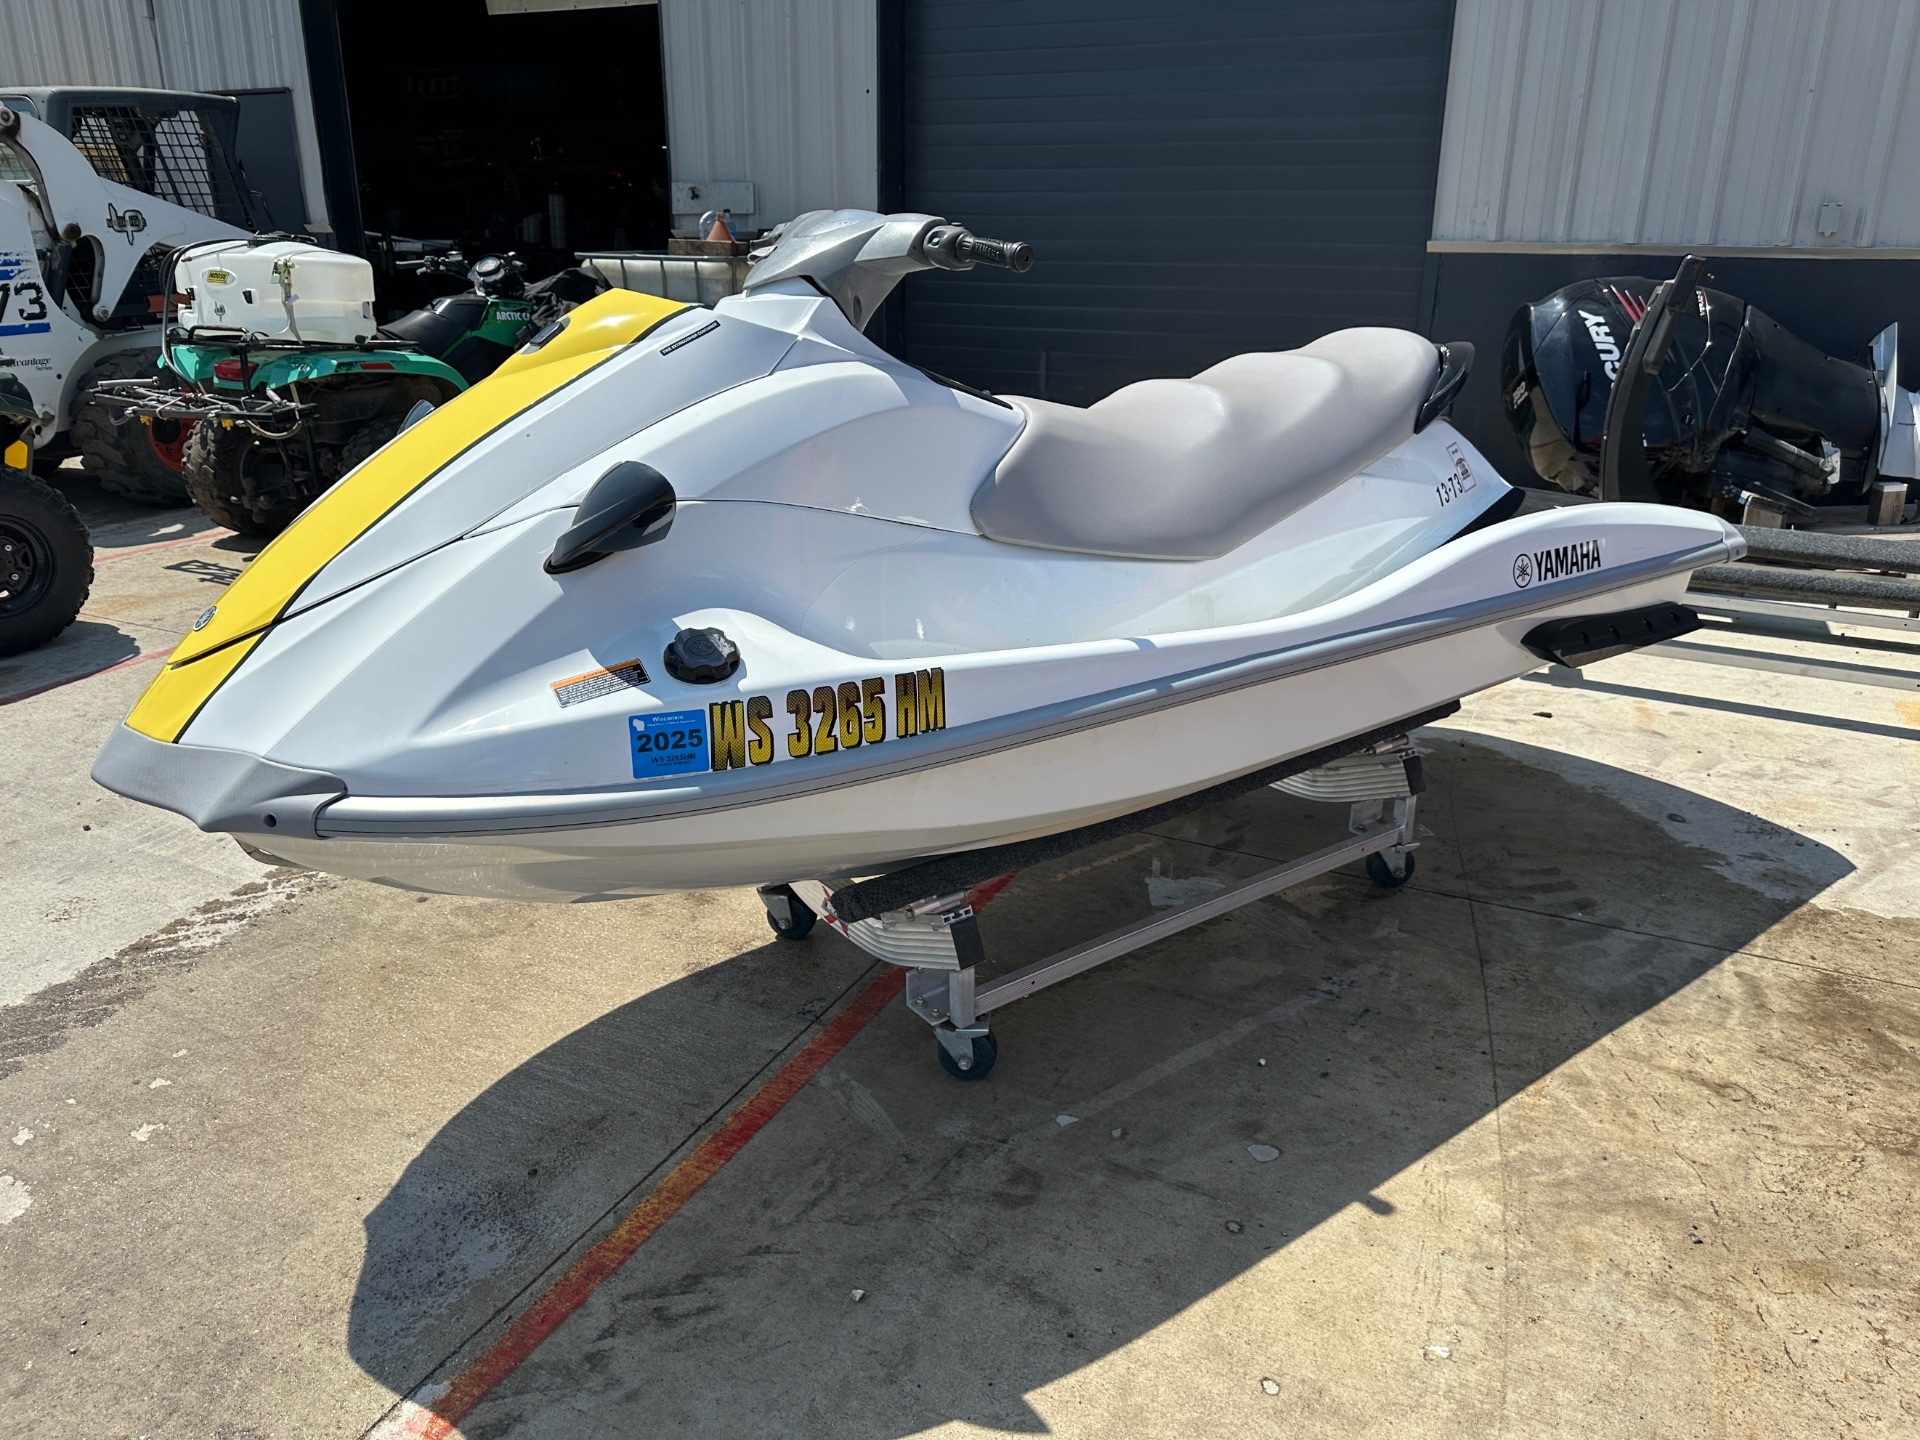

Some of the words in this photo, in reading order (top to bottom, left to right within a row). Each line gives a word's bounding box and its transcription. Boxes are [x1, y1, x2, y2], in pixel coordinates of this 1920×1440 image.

[496, 311, 521, 321] ARCTIC
[6, 357, 51, 368] vantage
[1578, 309, 1621, 389] CURY
[1436, 473, 1463, 507] 13-73
[1533, 539, 1601, 582] YAMAHA
[709, 695, 774, 771] WS
[786, 676, 886, 758] 3265
[895, 667, 946, 738] HM
[636, 728, 703, 753] 2025
[651, 755, 664, 763] WS
